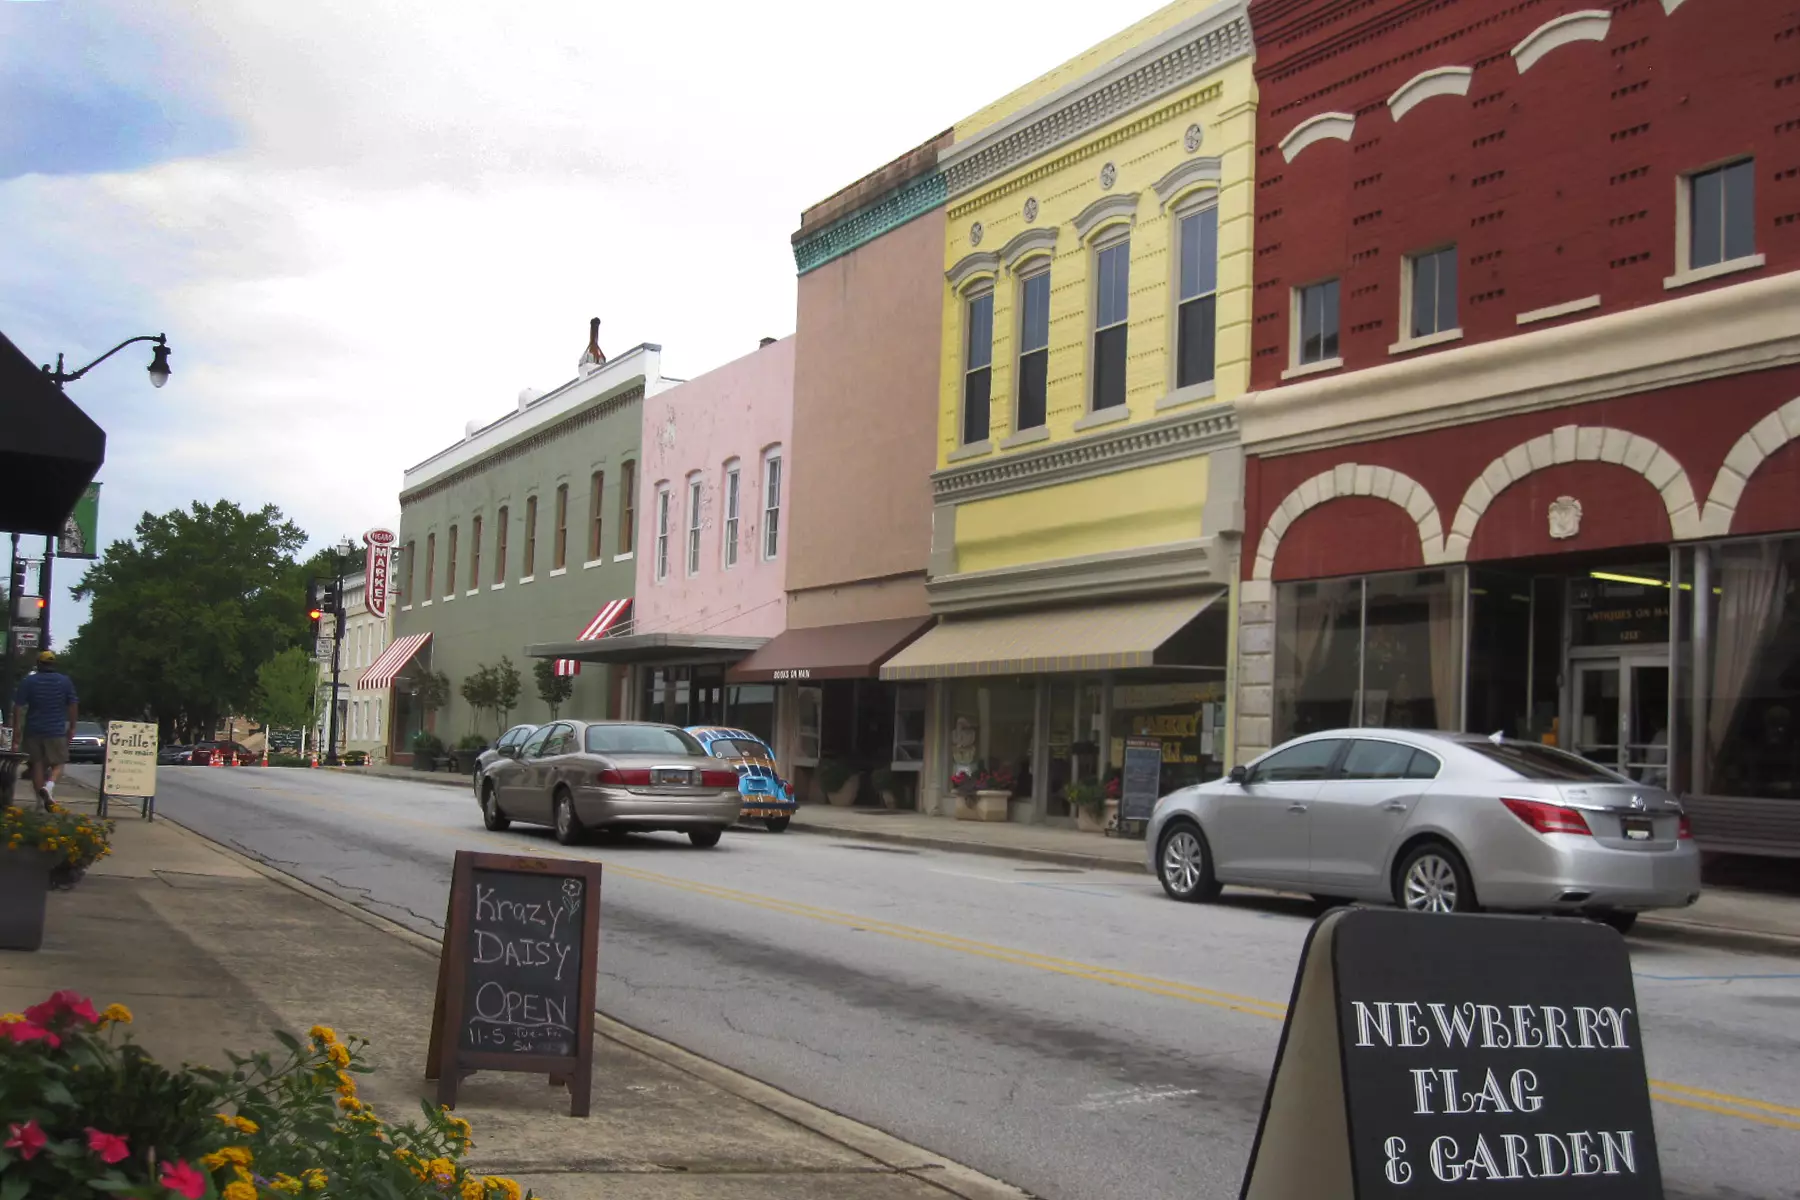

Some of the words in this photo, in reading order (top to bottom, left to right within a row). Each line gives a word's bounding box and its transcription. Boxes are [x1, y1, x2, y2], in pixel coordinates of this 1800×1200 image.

[374, 547, 387, 609] MARKET
[1586, 609, 1632, 621] ANTIQUES
[1635, 608, 1651, 618] ON
[773, 669, 789, 679] BOOKS
[790, 669, 797, 679] ON
[798, 669, 811, 679] MAIN
[110, 732, 149, 748] Grille
[475, 884, 563, 939] Krazy
[1351, 1000, 1632, 1049] NEWBERRY
[1409, 1066, 1544, 1115] FLAG
[1384, 1135, 1413, 1185] &
[1429, 1130, 1637, 1182] GARDEN
